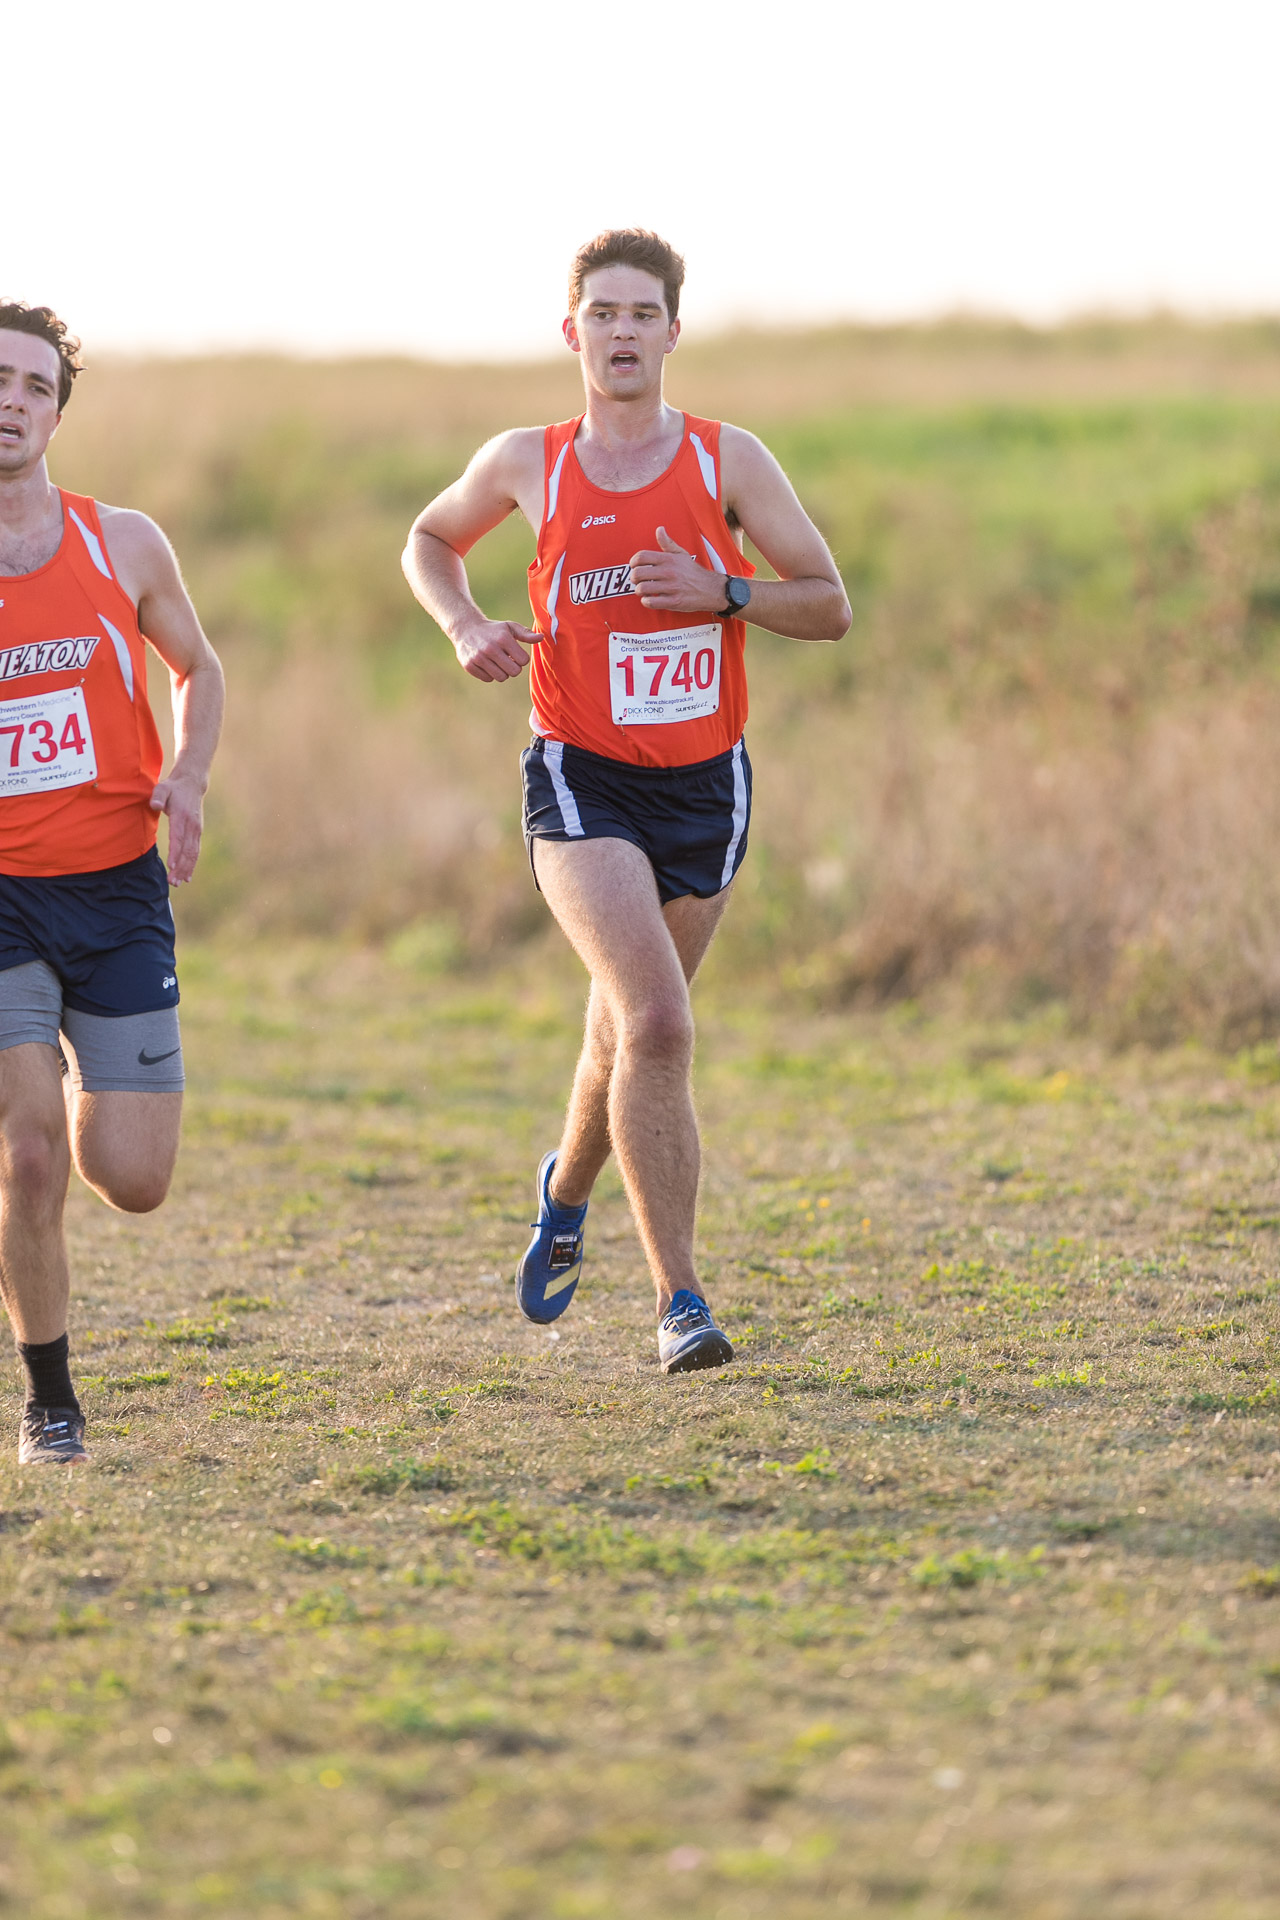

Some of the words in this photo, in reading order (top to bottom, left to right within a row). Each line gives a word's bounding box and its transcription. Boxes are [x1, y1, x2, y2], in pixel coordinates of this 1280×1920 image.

[631, 635, 683, 645] Northwestern
[683, 629, 710, 640] Medicine
[667, 643, 688, 652] Course
[616, 648, 715, 697] 1740
[643, 706, 665, 714] POND
[0, 712, 87, 768] 734
